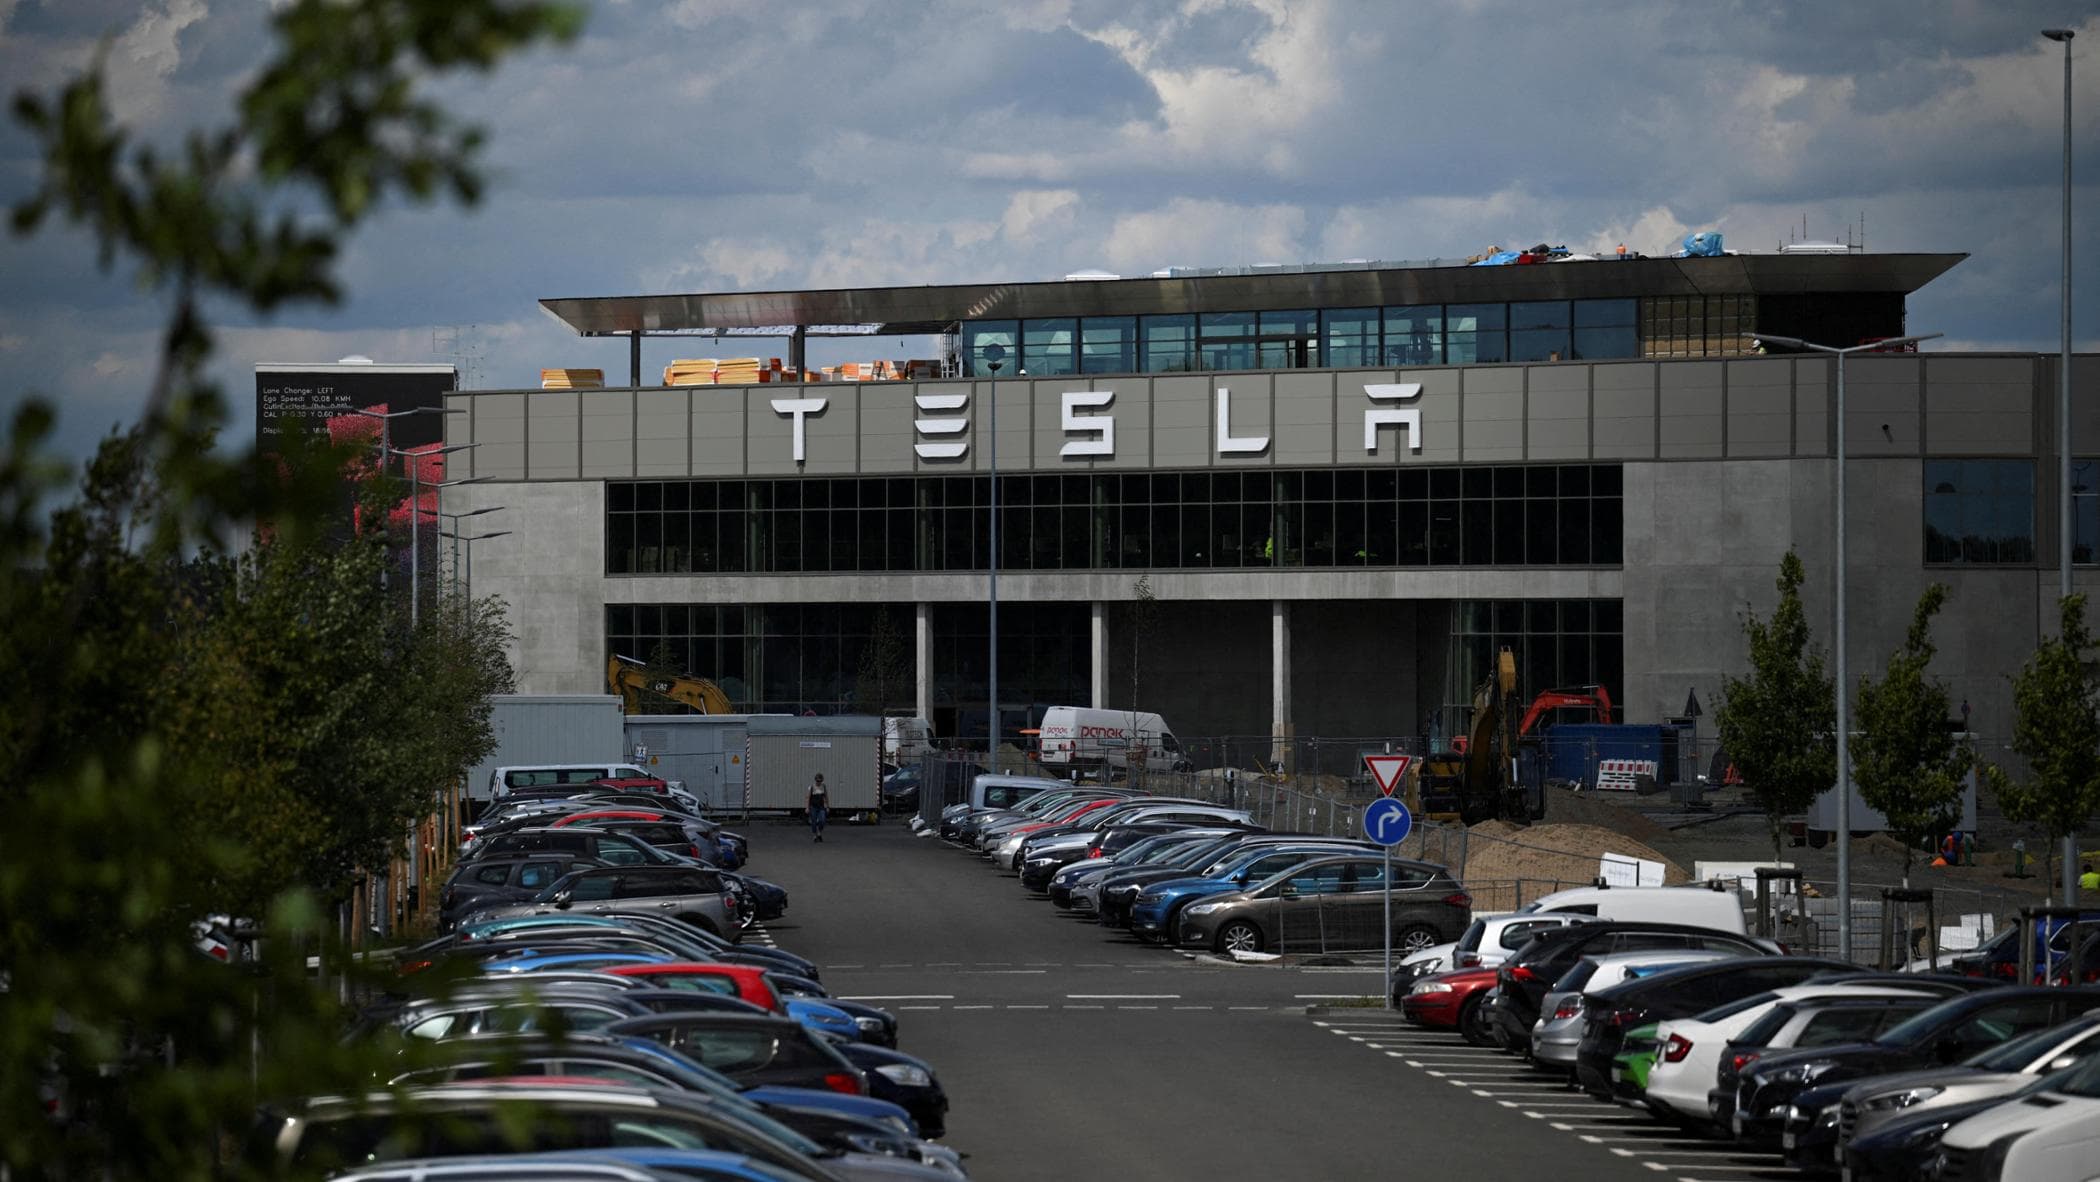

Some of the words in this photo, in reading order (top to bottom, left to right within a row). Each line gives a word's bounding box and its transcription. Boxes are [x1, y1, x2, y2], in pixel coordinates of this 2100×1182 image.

[284, 387, 312, 396] Change:
[263, 395, 277, 403] Ego
[280, 395, 305, 403] Speed:
[771, 383, 1422, 463] TESLA
